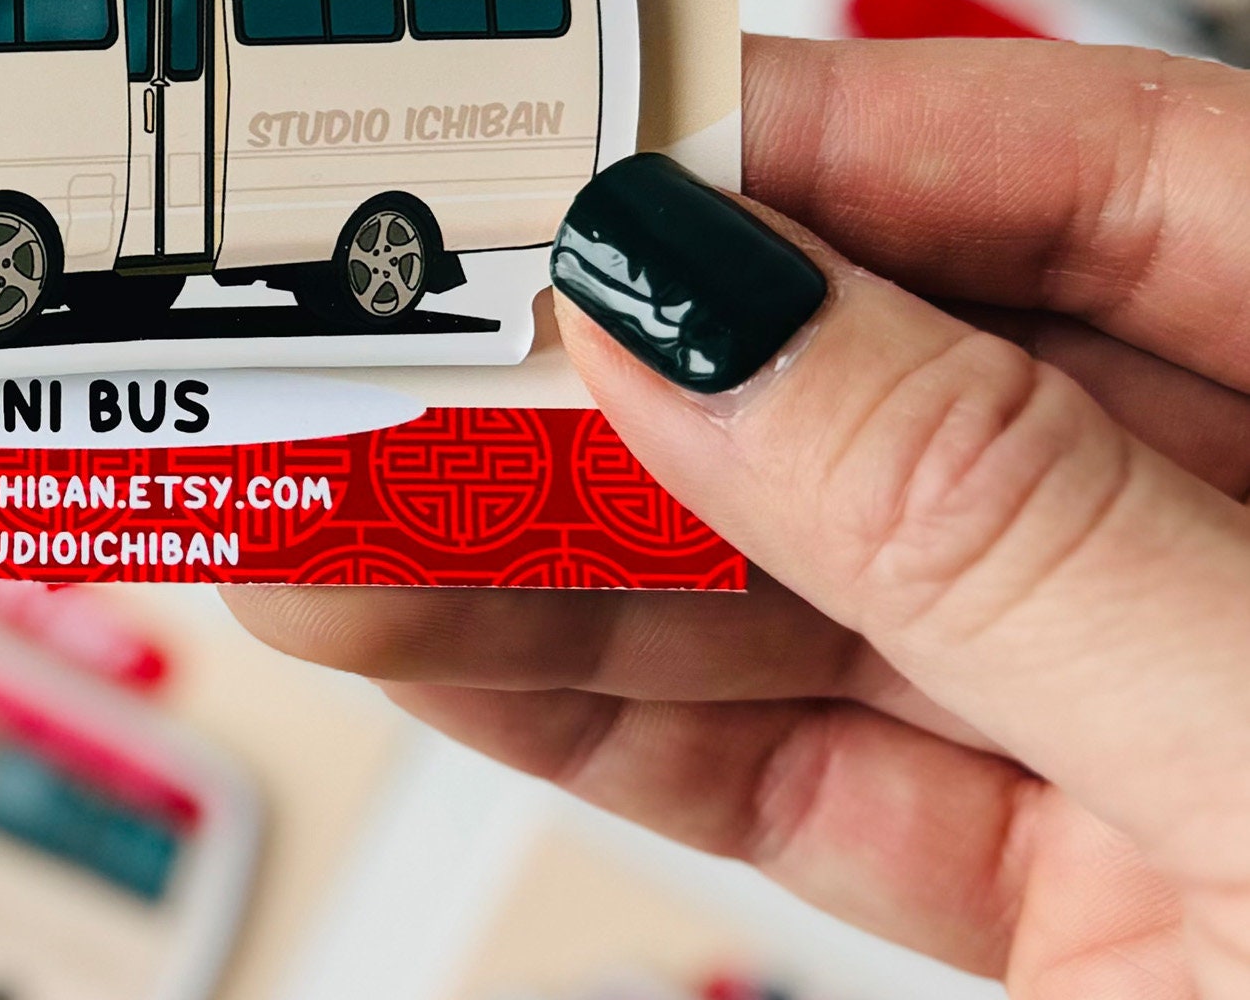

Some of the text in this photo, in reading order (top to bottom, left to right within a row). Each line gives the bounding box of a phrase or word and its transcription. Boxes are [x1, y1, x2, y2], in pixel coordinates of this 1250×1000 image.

[247, 100, 566, 149] STUDIO ICHIBAN
[88, 379, 211, 434] BUS
